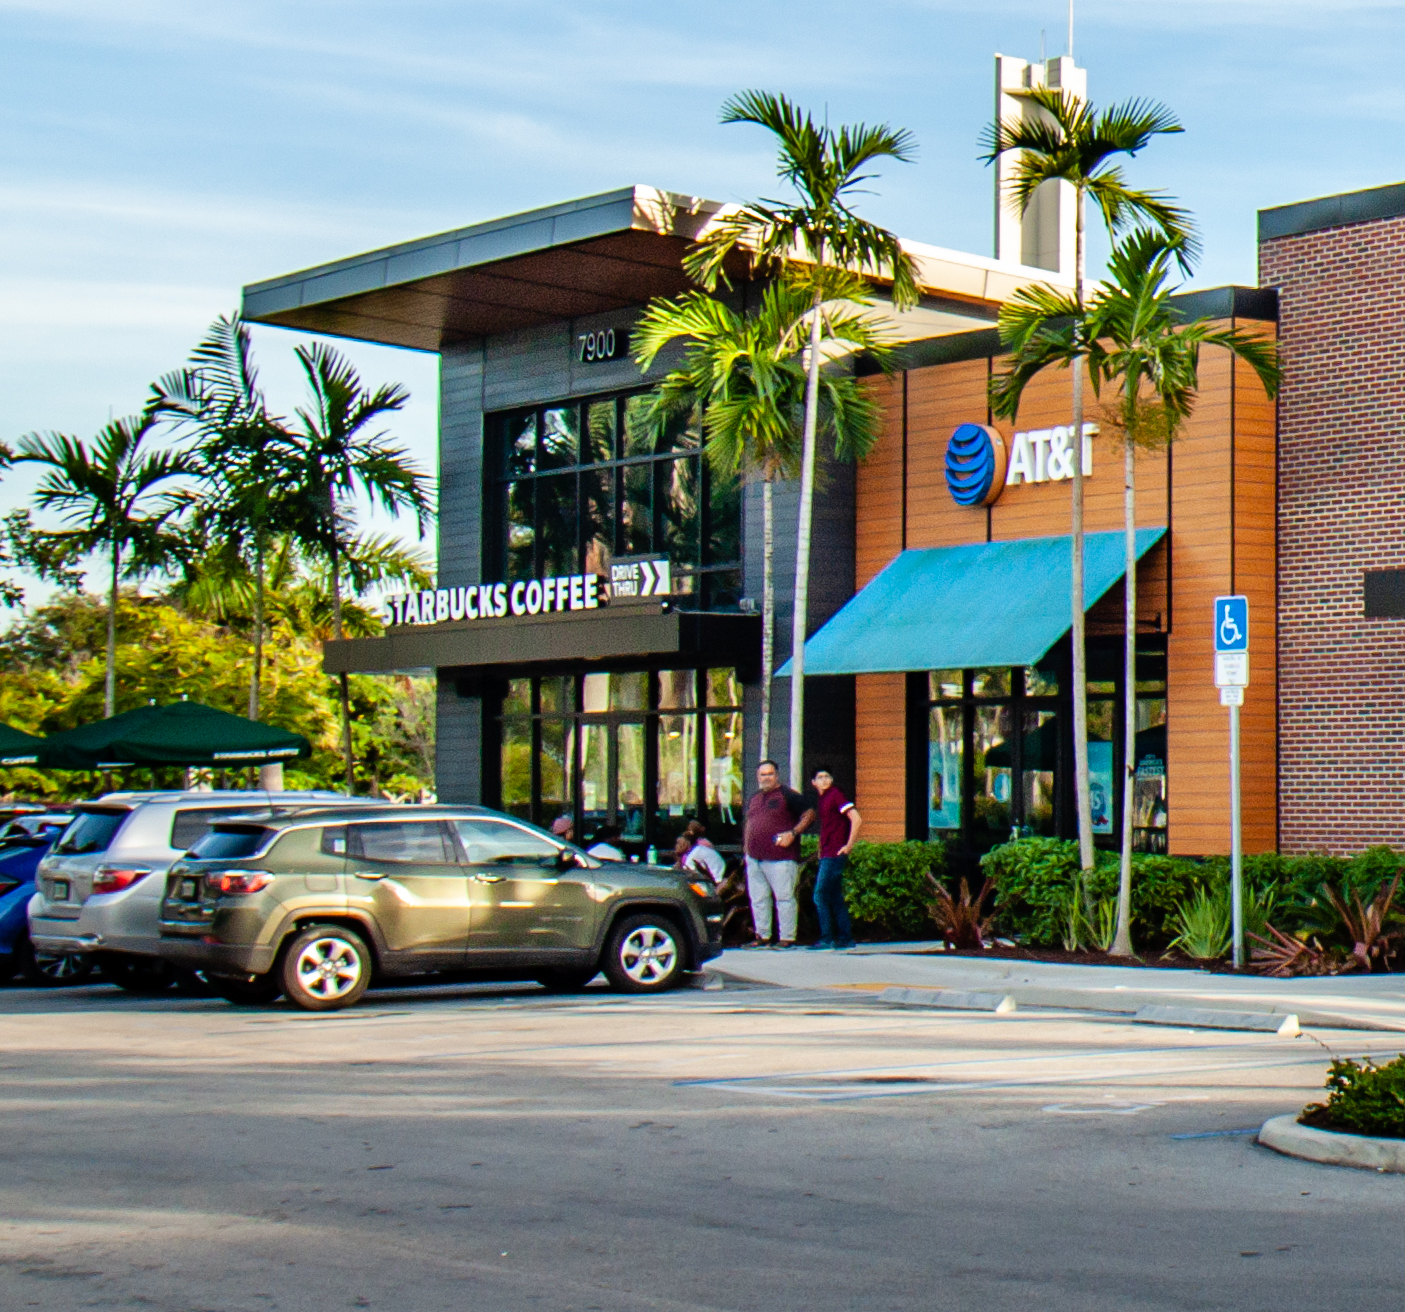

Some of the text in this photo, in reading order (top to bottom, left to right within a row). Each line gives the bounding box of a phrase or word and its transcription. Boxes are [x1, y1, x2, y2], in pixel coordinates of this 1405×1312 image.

[578, 329, 615, 362] 7900
[1006, 423, 1099, 485] AT&T
[611, 563, 639, 581] DRIVE
[381, 573, 598, 626] STARBUCKS COFFEE
[612, 581, 638, 597] THRU
